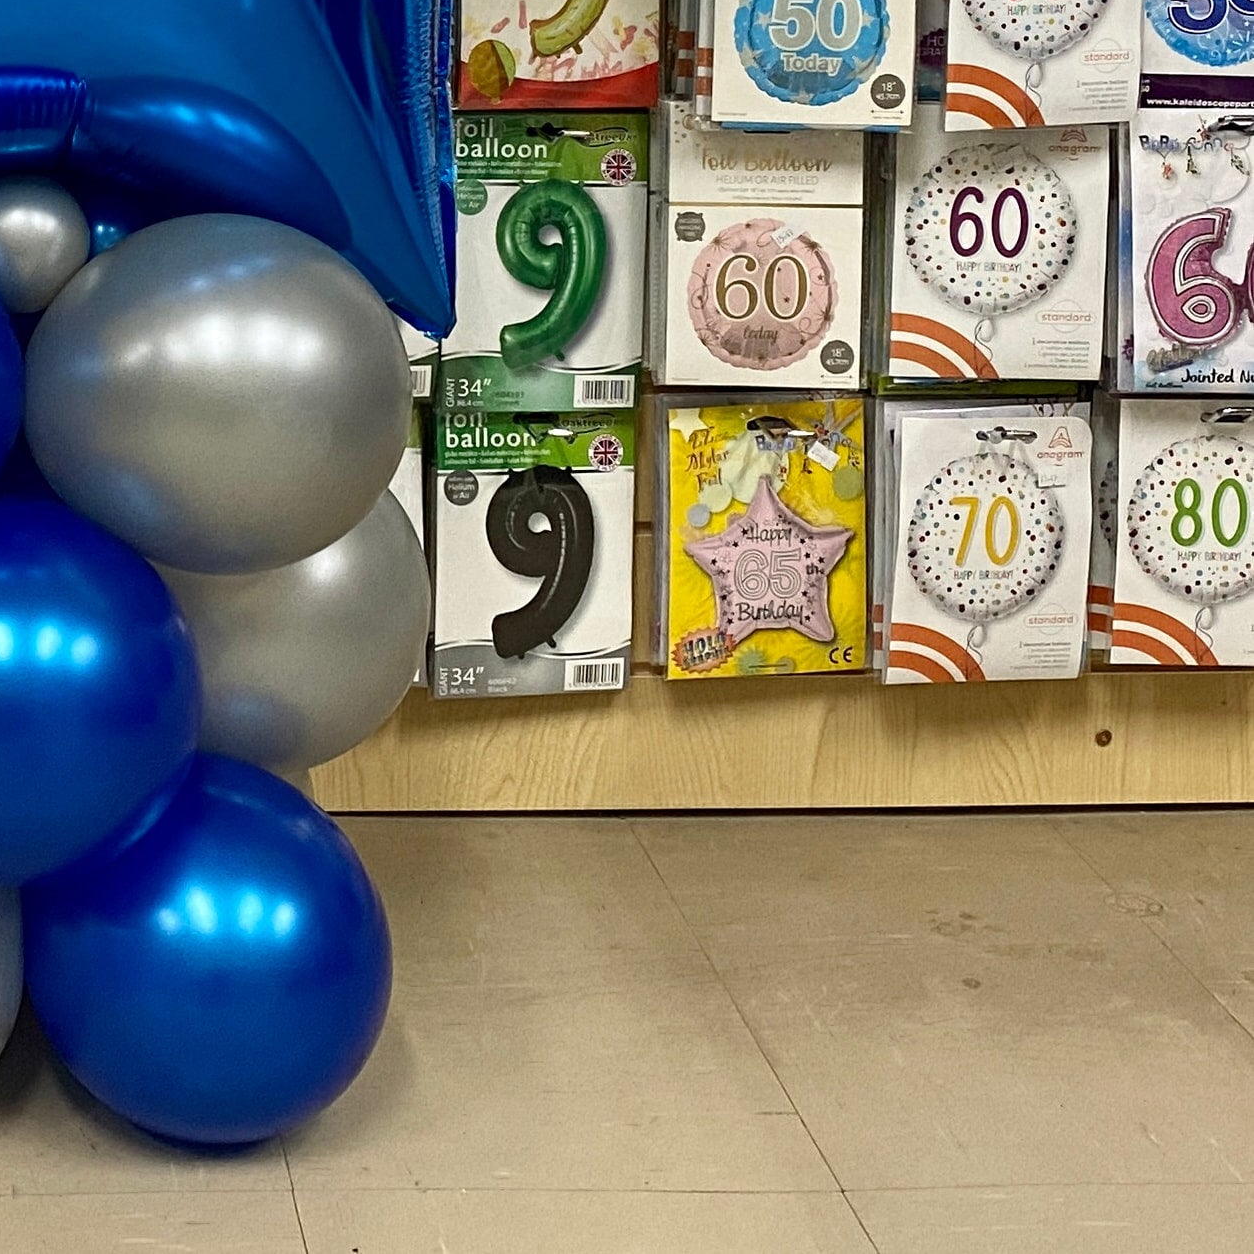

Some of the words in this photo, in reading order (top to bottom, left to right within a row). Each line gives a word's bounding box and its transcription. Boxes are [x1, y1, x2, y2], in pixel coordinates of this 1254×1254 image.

[780, 52, 843, 76] Today
[1083, 51, 1130, 62] standard
[455, 138, 548, 159] balloon
[949, 186, 1029, 258] 60
[714, 254, 810, 322] 60
[1041, 312, 1092, 323] standard
[743, 324, 779, 342] today
[1181, 367, 1235, 384] Jointed
[457, 378, 492, 398] 34"
[1037, 450, 1084, 462] anagram
[1170, 477, 1250, 548] 80
[950, 495, 1021, 567] 70
[733, 548, 802, 600] 65
[736, 600, 804, 625] Birthday
[450, 666, 484, 687] 34"
